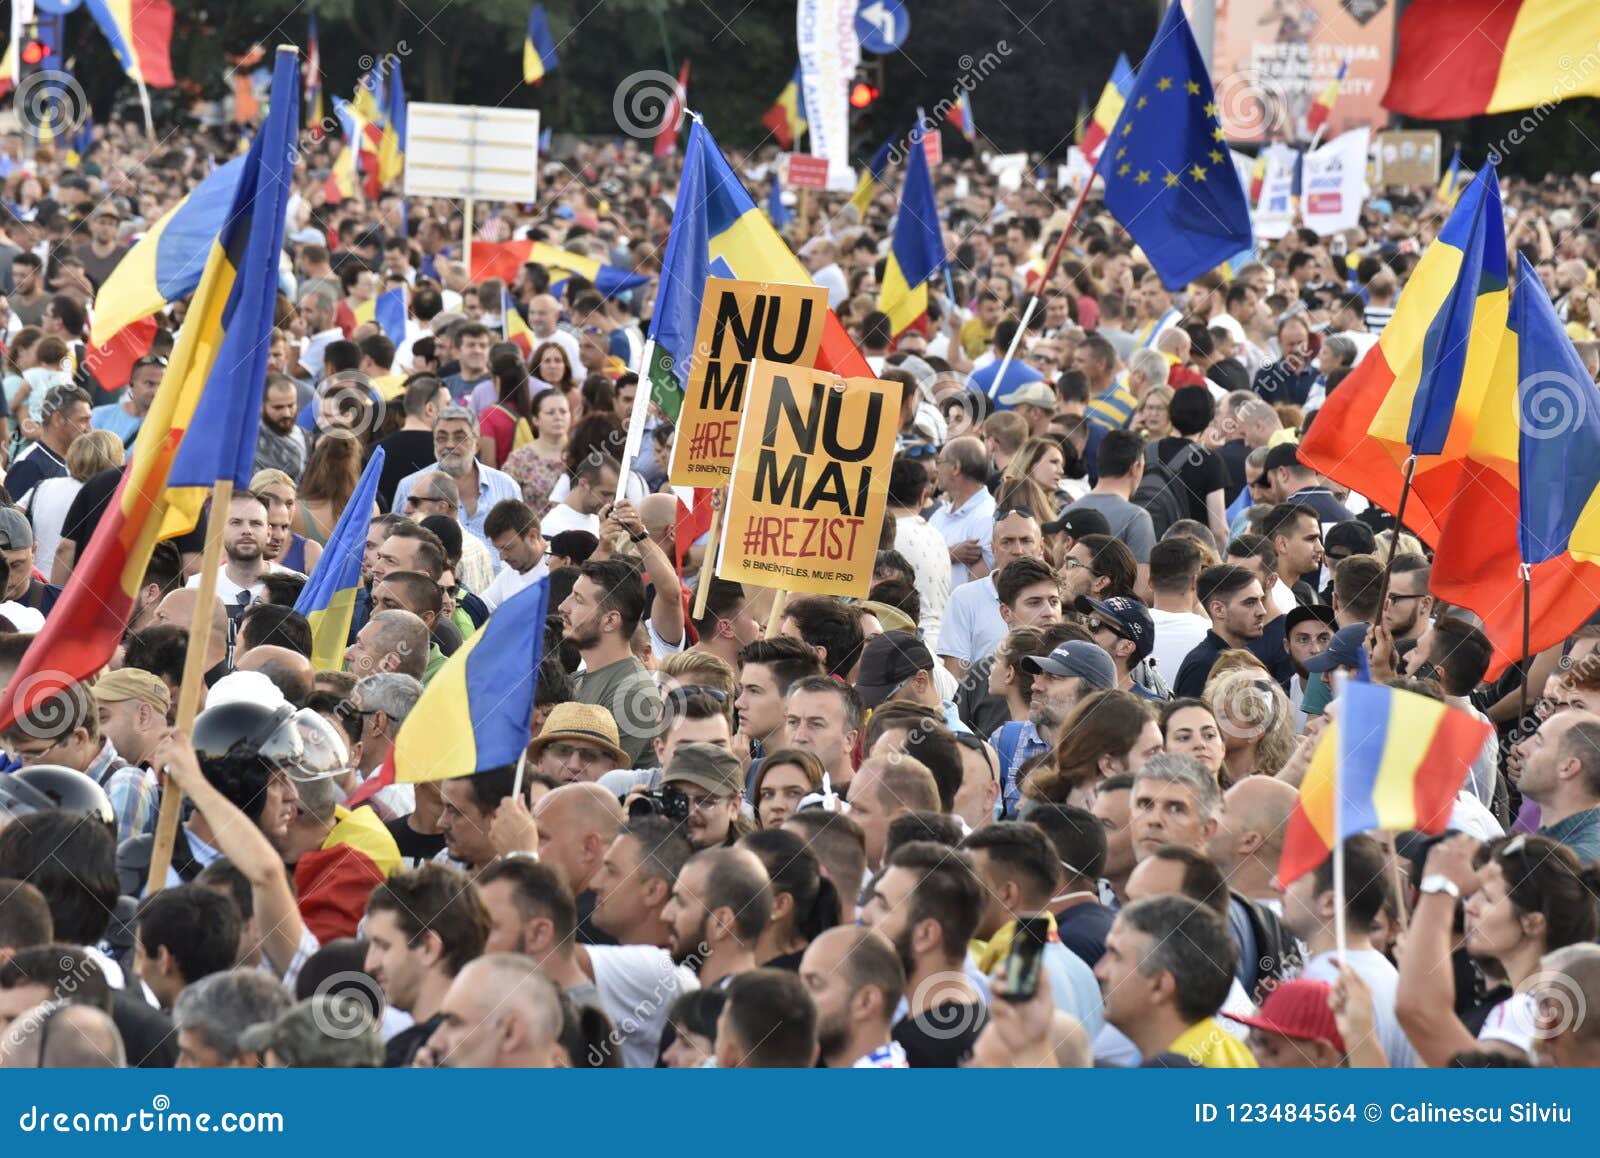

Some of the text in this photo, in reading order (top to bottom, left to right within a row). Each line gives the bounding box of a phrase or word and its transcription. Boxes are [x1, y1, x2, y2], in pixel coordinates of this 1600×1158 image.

[709, 291, 813, 364] NU
[762, 376, 884, 462] NU
[752, 449, 872, 517] MAI
[743, 516, 864, 561] #REZIST
[812, 570, 833, 580] MUIE
[835, 572, 853, 582] PSD
